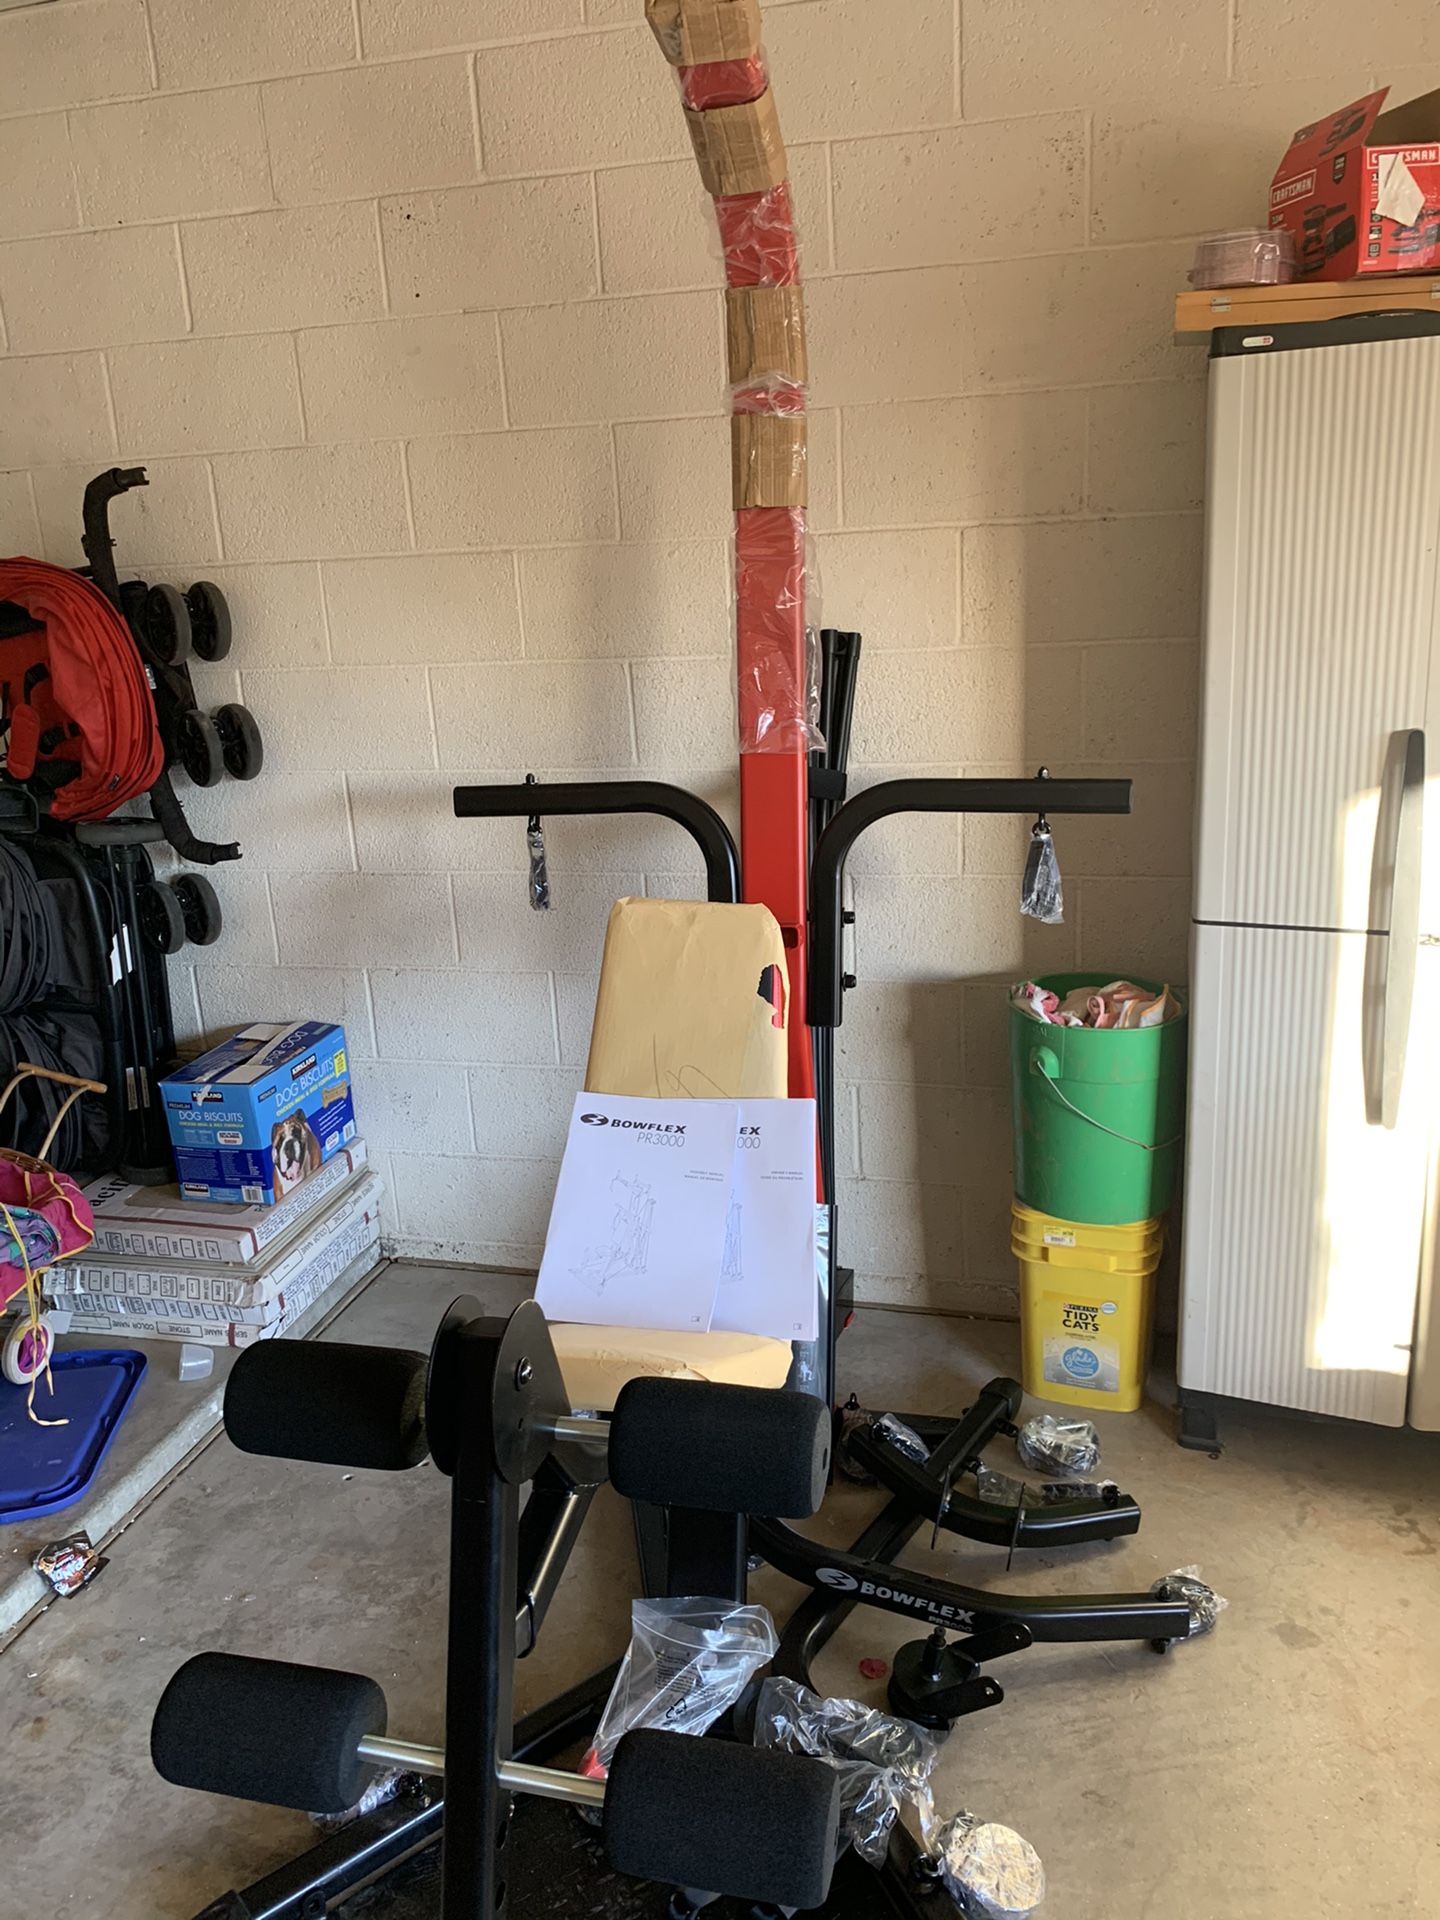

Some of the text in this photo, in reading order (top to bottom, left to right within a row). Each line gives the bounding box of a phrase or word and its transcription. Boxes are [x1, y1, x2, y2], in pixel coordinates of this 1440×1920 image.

[1272, 177, 1314, 204] CRAFTSMAN
[292, 1055, 316, 1074] KIRKLAND
[275, 1082, 299, 1107] DOG
[300, 1057, 334, 1090] BISCUITS
[178, 1110, 244, 1123] DOG BISCUITS
[610, 1118, 687, 1135] BOWFLEX
[636, 1131, 686, 1148] PR3000
[1063, 1310, 1097, 1322] TIDY
[112, 1319, 155, 1331] COLOR NAME
[168, 1324, 191, 1334] STONE
[204, 1327, 223, 1337] NAME
[1062, 1318, 1100, 1332] CATS
[860, 1581, 976, 1624] BOWFLEX
[927, 1614, 973, 1632] PR3000
